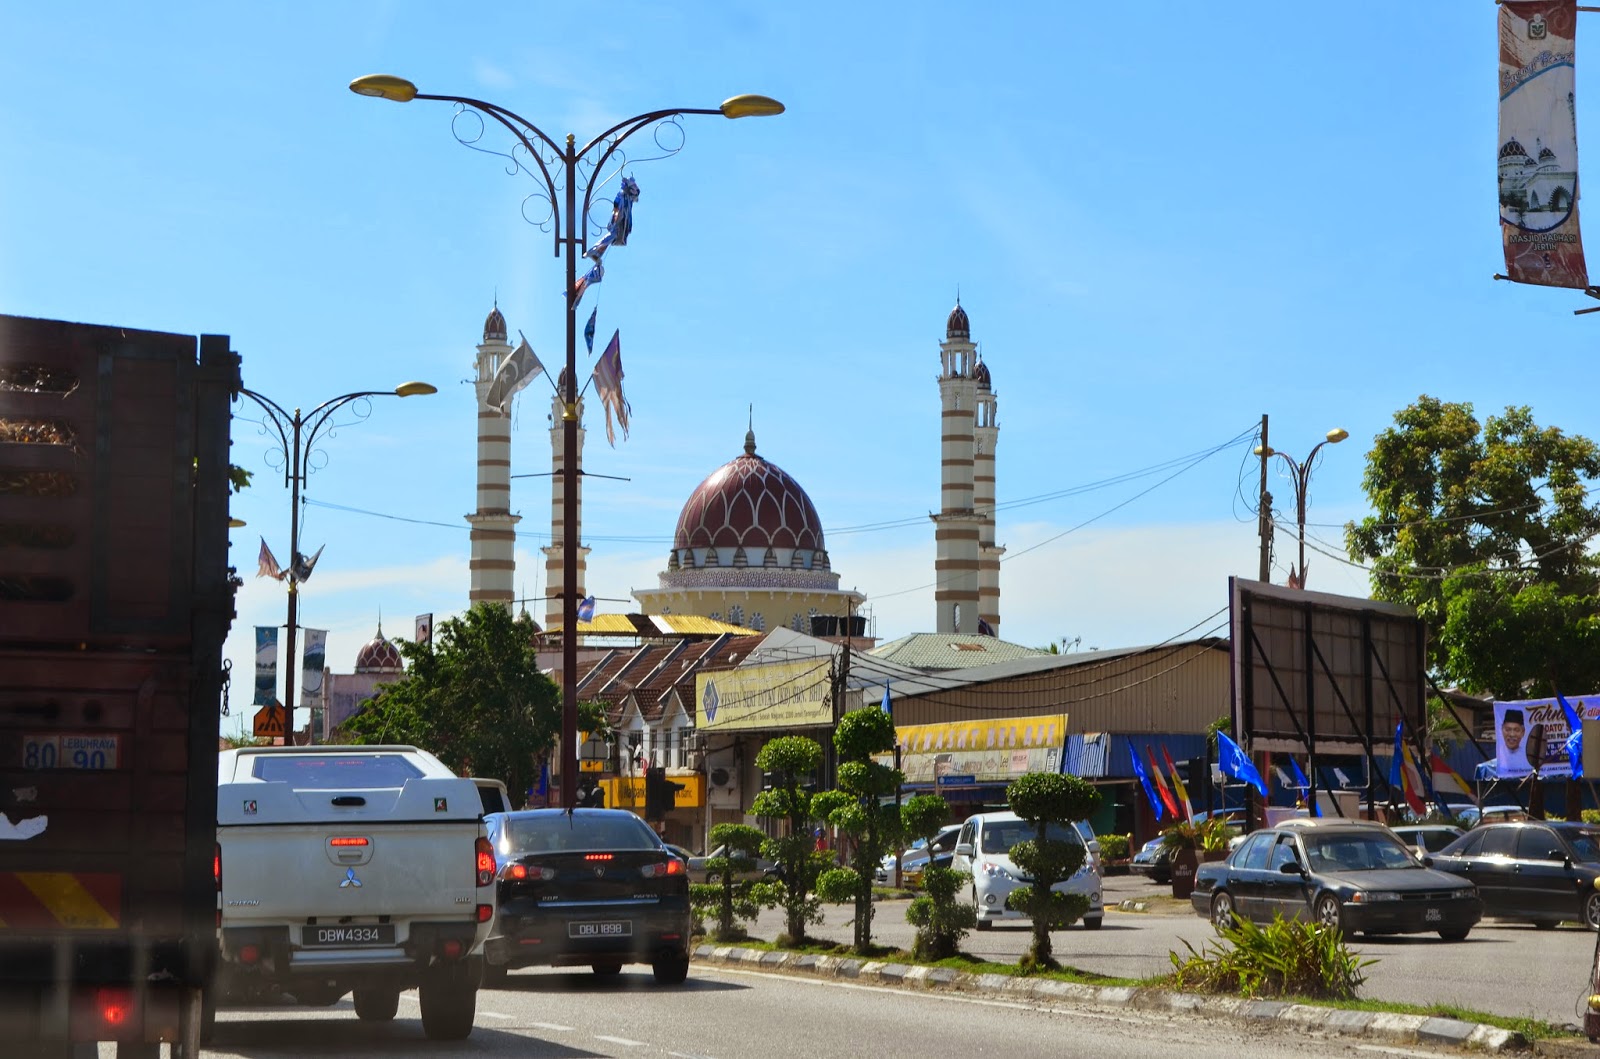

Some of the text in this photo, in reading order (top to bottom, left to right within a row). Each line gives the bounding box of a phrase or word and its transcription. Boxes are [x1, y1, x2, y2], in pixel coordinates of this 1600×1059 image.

[1509, 234, 1540, 243] MASJID
[63, 737, 115, 749] LEBUHRAYA
[25, 741, 56, 768] 80
[73, 750, 105, 769] 90
[318, 928, 379, 942] DBW4334
[600, 923, 622, 934] 1898
